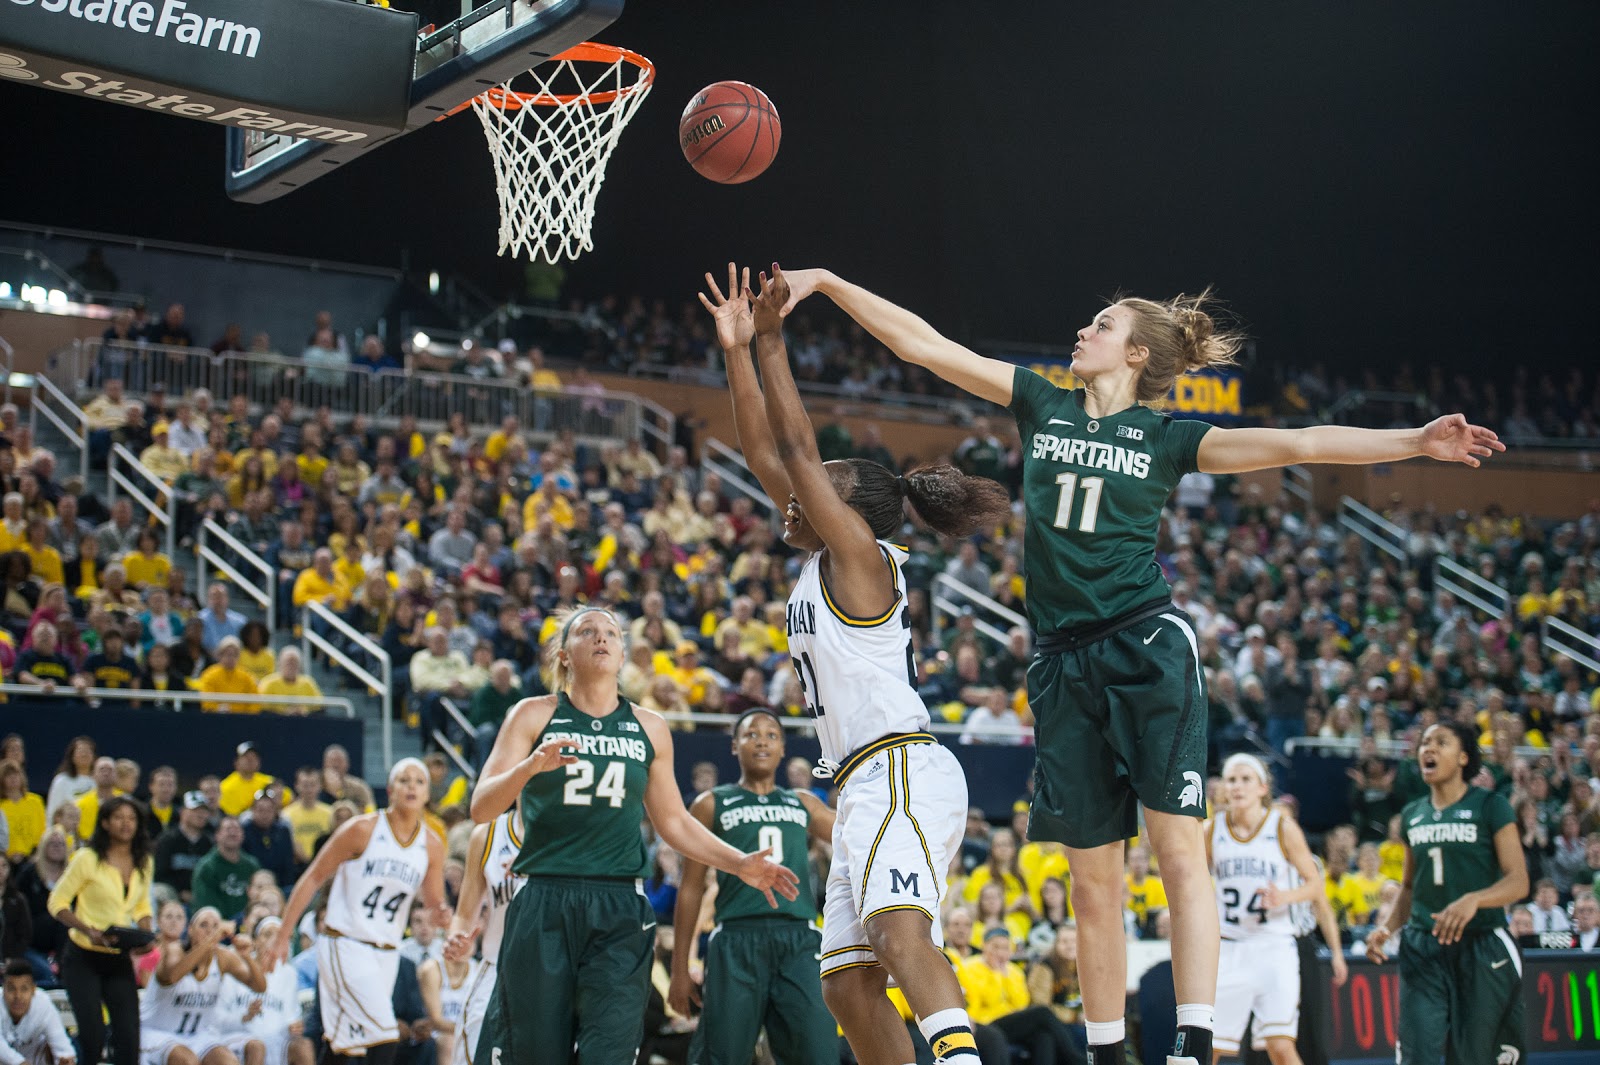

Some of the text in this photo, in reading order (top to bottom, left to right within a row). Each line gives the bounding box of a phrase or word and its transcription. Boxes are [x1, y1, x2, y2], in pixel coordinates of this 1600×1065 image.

[43, 71, 368, 143] State Farm
[1031, 433, 1152, 480] SPARTANS
[1053, 471, 1105, 533] 11
[563, 759, 627, 808] 24
[720, 804, 808, 831] SPARTANS
[758, 825, 784, 865] 0
[889, 868, 921, 898] M
[1427, 847, 1444, 886] 1
[362, 885, 408, 923] 44
[1223, 888, 1268, 924] 24
[176, 1012, 202, 1035] 11
[349, 1023, 365, 1039] M
